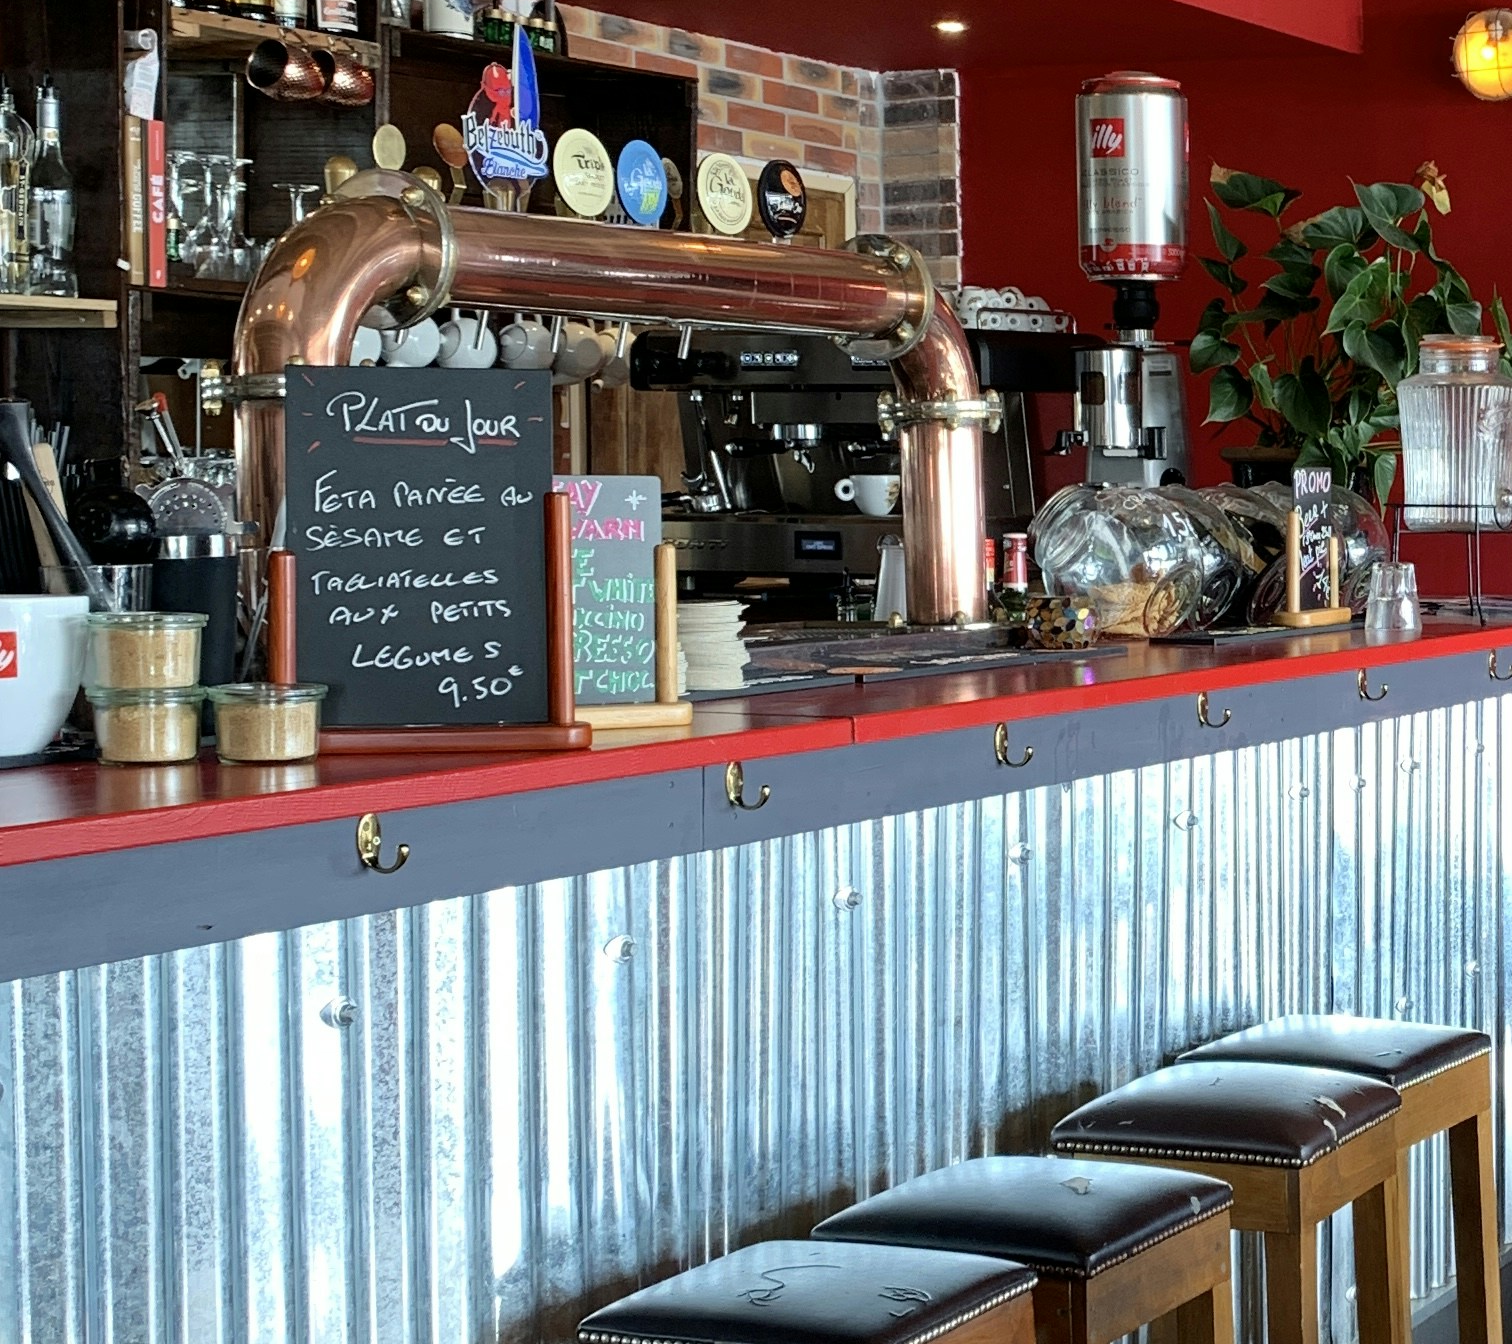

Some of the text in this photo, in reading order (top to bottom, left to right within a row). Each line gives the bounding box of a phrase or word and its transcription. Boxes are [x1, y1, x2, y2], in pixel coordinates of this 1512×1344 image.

[1092, 123, 1123, 155] illy
[326, 391, 521, 455] PLAT DU JOUR
[314, 469, 376, 514] FETA
[1294, 468, 1331, 499] PROMO
[443, 526, 486, 546] ET
[311, 569, 499, 596] TAGLIATELLES
[329, 599, 512, 626] AUX PETITS
